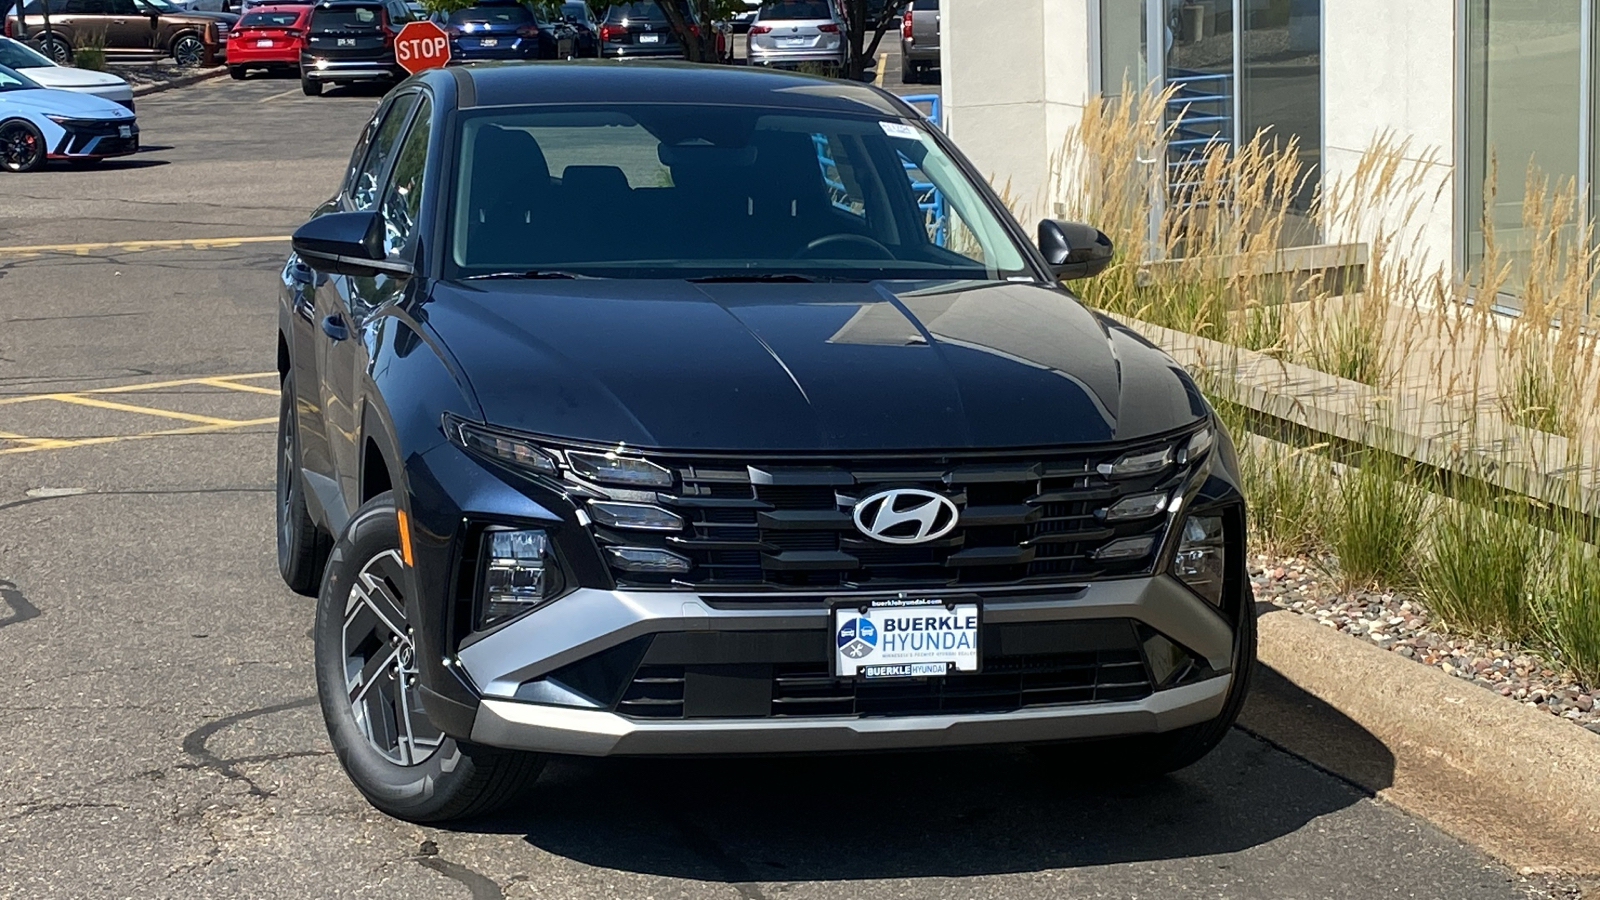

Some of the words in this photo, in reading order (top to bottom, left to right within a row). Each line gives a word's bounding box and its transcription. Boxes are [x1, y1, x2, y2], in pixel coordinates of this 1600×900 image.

[399, 37, 446, 60] STOP
[883, 616, 977, 632] BUERKLE
[882, 631, 976, 652] HYUNDAI
[867, 665, 911, 676] BUERKLE
[912, 664, 945, 674] HYUNDAI
